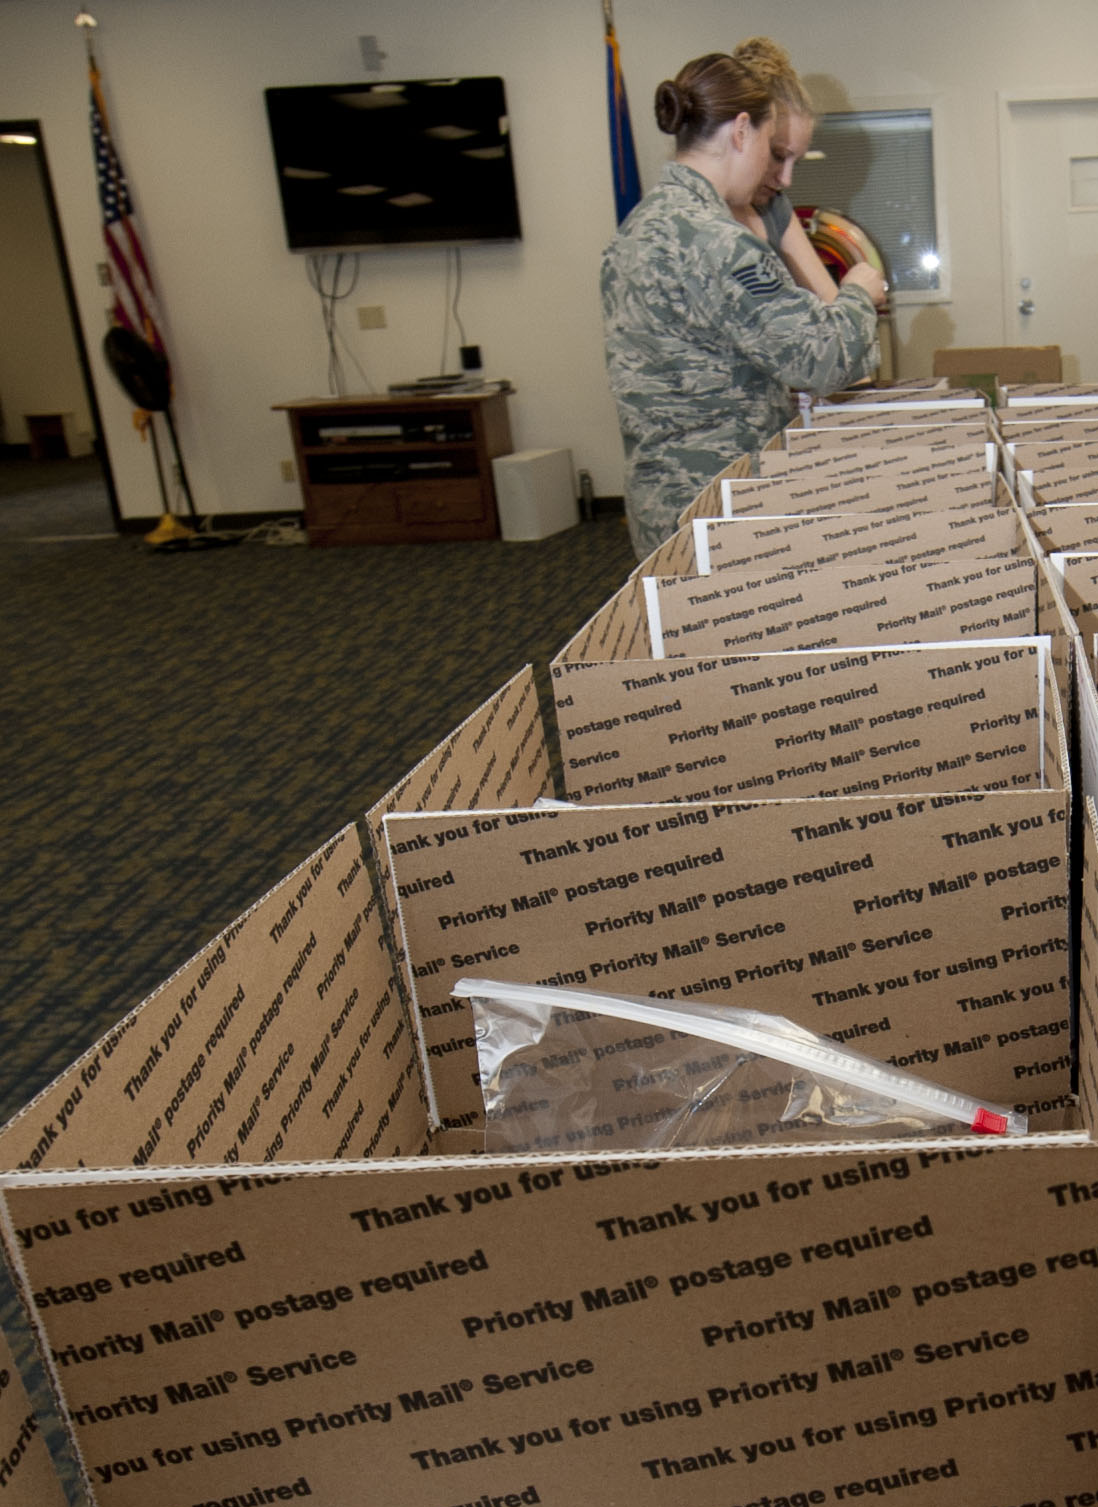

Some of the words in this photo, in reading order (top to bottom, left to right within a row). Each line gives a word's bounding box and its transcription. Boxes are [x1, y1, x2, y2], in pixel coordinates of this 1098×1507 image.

[822, 529, 851, 541] Thank
[852, 526, 869, 535] you
[870, 521, 883, 529] for
[886, 514, 911, 525] using
[668, 725, 719, 744] Priority
[762, 701, 816, 724] postage
[820, 683, 878, 707] required
[520, 840, 581, 865] Thank
[583, 832, 619, 853] you
[623, 824, 650, 840] for
[656, 810, 709, 832] using
[812, 983, 872, 1006] Thank
[874, 976, 909, 995] you
[913, 968, 941, 983] for
[946, 955, 998, 976] using
[123, 1045, 163, 1101] Thank
[160, 1013, 182, 1052] you
[180, 986, 197, 1016] for
[197, 945, 226, 990] using
[16, 1219, 72, 1249] you
[76, 1206, 120, 1230] for
[128, 1185, 213, 1218] using
[350, 1194, 451, 1232] Thank
[454, 1182, 512, 1214] you
[518, 1168, 564, 1194] for
[94, 1457, 149, 1484] you
[151, 1446, 194, 1467] for
[201, 1428, 282, 1456] using
[284, 1402, 391, 1438] Priority
[483, 1359, 594, 1394] Service
[410, 1437, 504, 1470] Thank
[508, 1428, 563, 1455] you
[569, 1416, 611, 1437] for
[620, 1398, 702, 1426] using
[707, 1372, 818, 1408] Priority
[914, 1328, 1029, 1364] Service
